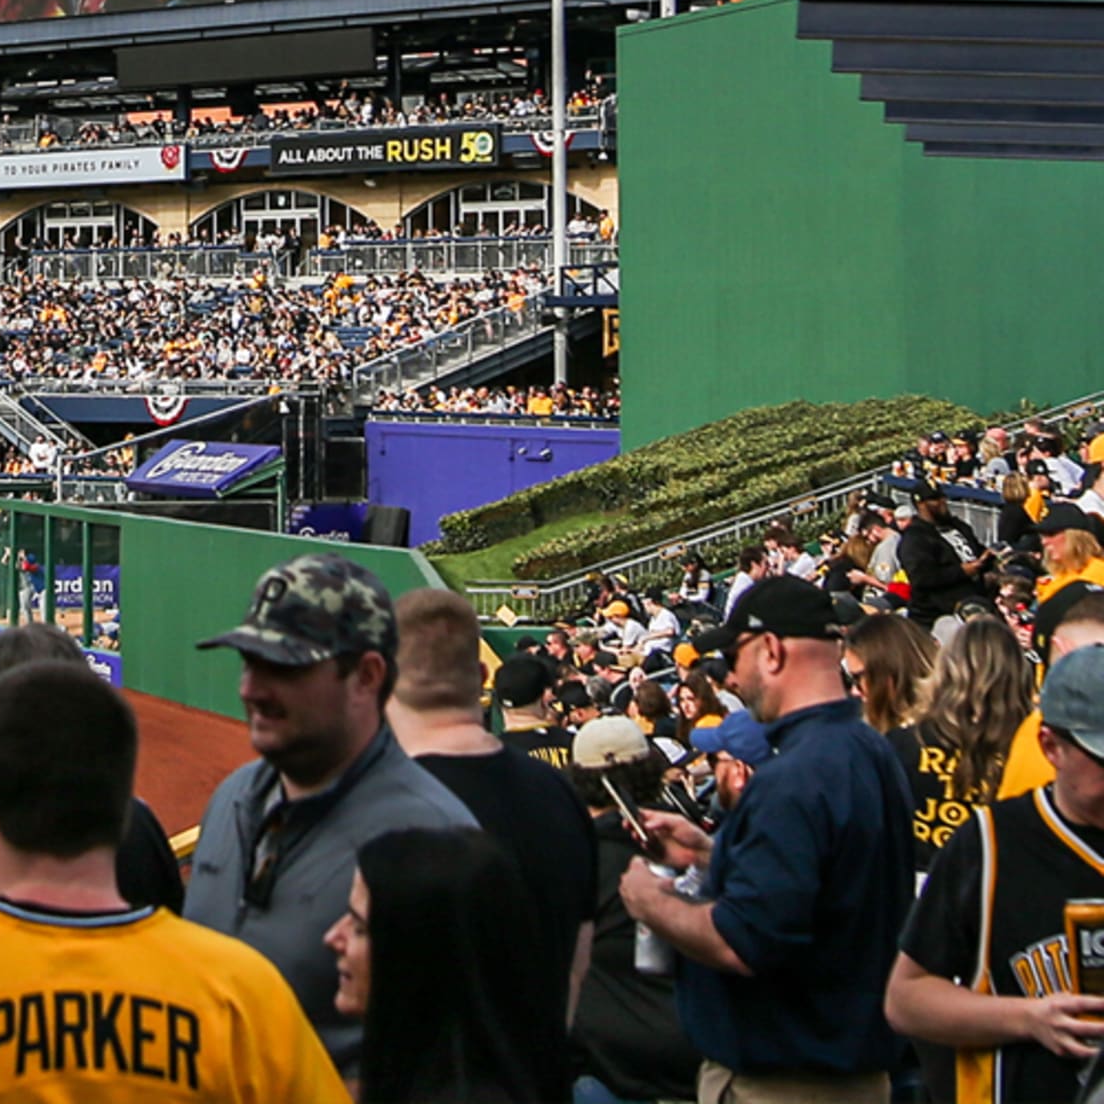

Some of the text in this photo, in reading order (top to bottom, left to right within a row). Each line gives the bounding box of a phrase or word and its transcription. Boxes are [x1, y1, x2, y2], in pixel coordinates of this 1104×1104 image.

[278, 150, 304, 165] ALL
[306, 147, 353, 163] ABOUT
[356, 144, 384, 161] THE
[386, 137, 452, 163] RUSH
[4, 164, 17, 176] TO
[21, 162, 48, 175] YOUR
[53, 160, 97, 173] PIRATES
[101, 158, 140, 170] FAMILY
